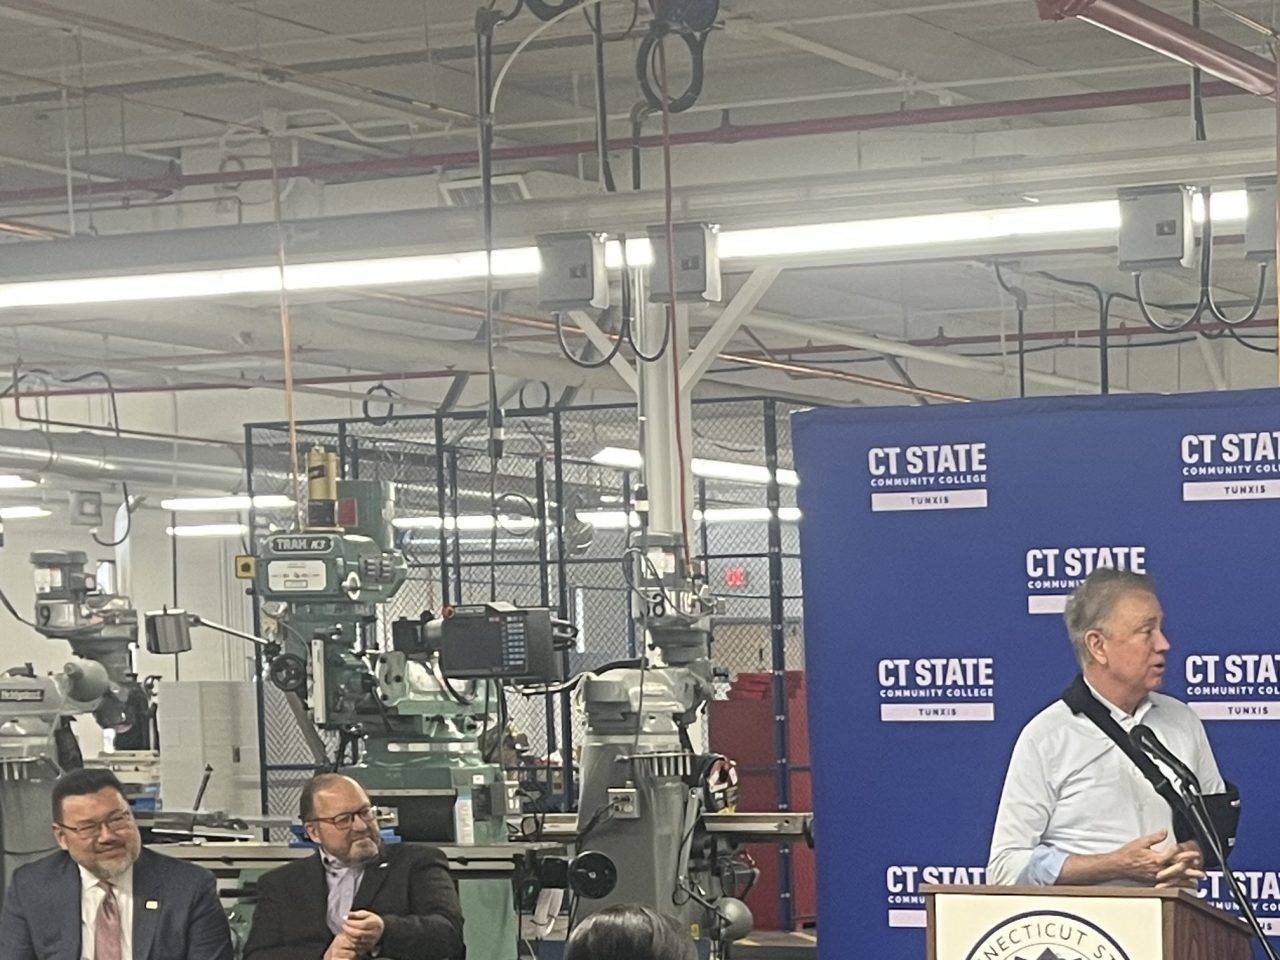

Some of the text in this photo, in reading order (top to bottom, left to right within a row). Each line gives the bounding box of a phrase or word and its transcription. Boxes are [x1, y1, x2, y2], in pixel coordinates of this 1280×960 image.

[1181, 434, 1217, 464] CT
[868, 442, 988, 476] CT STATE
[1182, 464, 1252, 476] COMMUNITY
[870, 473, 987, 487] COMMUNITY COLLEGE
[1223, 484, 1266, 495] TUNXIS
[910, 495, 950, 505] TUNXIS
[1026, 546, 1147, 578] CT STATE
[1027, 579, 1086, 589] COMMUNI
[878, 657, 994, 687] CT STATE
[1185, 654, 1220, 684] CT
[879, 687, 993, 698] COMMUNITY COLLEGE
[1186, 686, 1254, 696] COMMUNITY
[917, 708, 957, 717] TUNXIS
[1227, 706, 1269, 716] TUNXIS
[886, 865, 990, 894] CT STAT
[887, 895, 926, 905] COMMU
